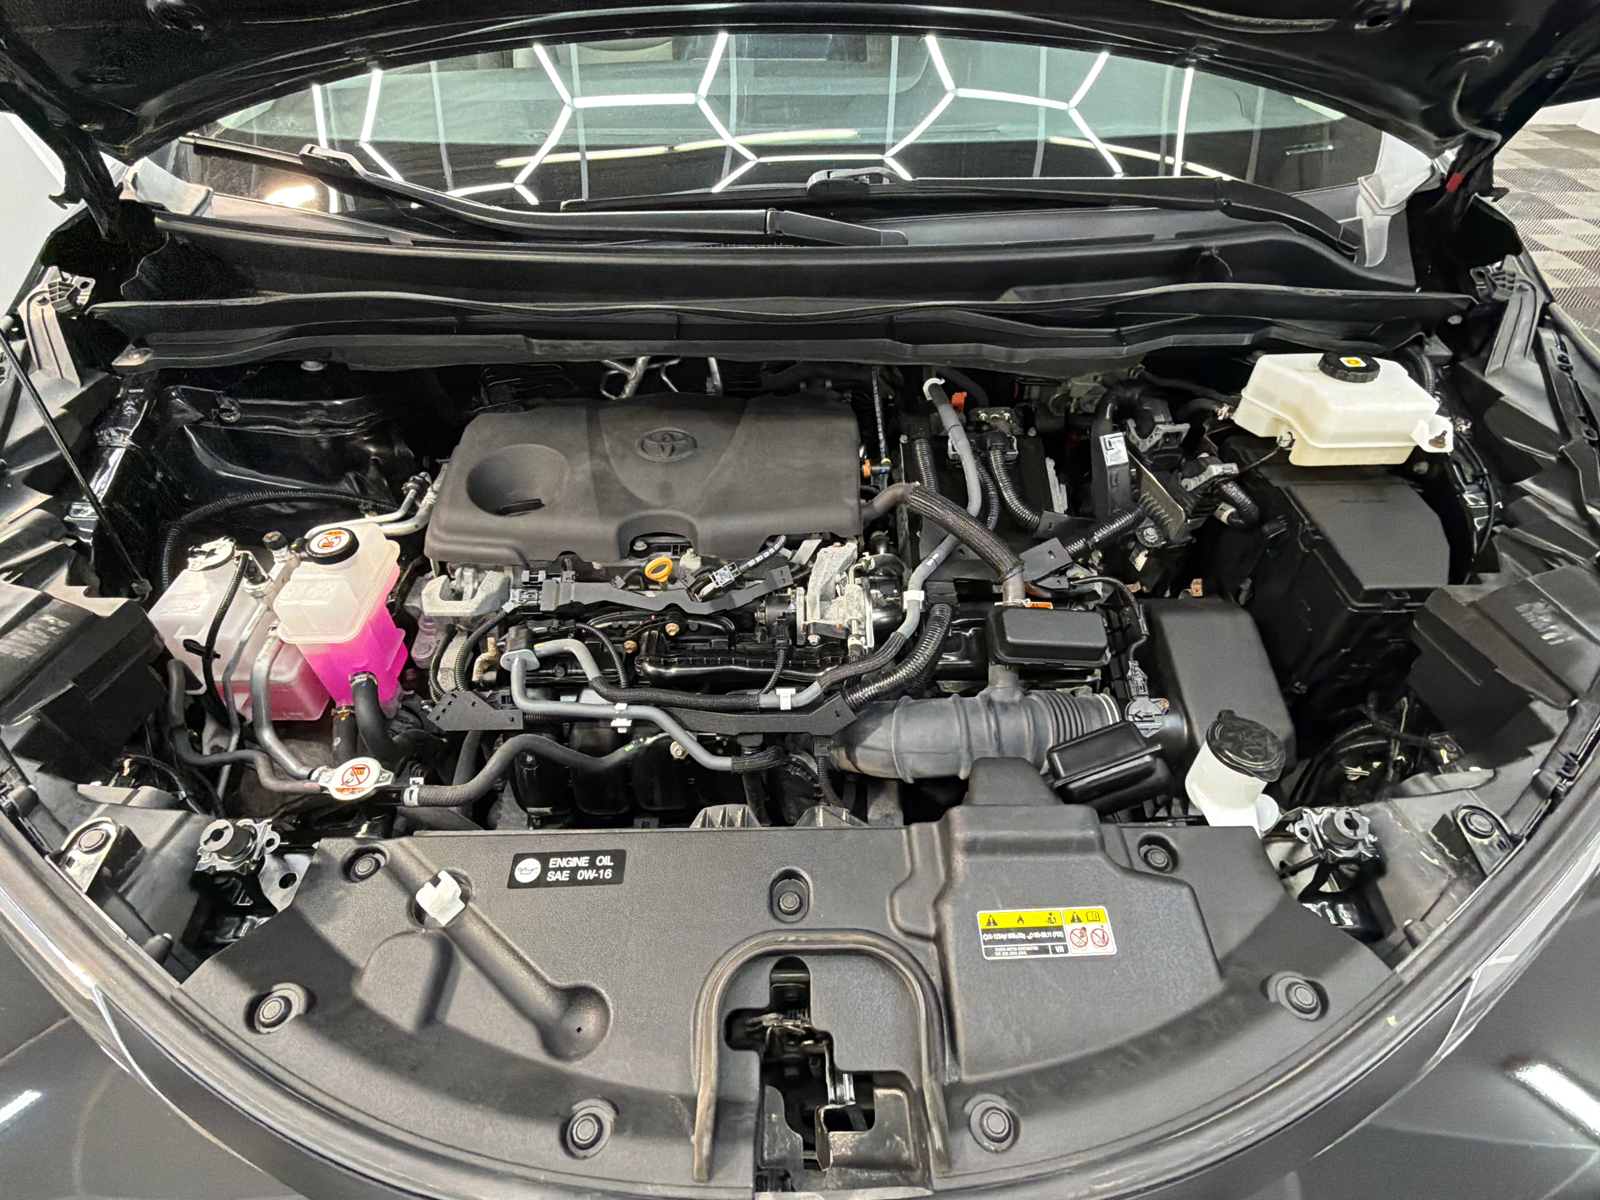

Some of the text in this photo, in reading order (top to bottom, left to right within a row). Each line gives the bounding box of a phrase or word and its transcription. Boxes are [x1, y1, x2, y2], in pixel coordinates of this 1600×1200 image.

[548, 855, 614, 868] ENGINE OIL
[546, 869, 613, 882] SAE 0W-16
